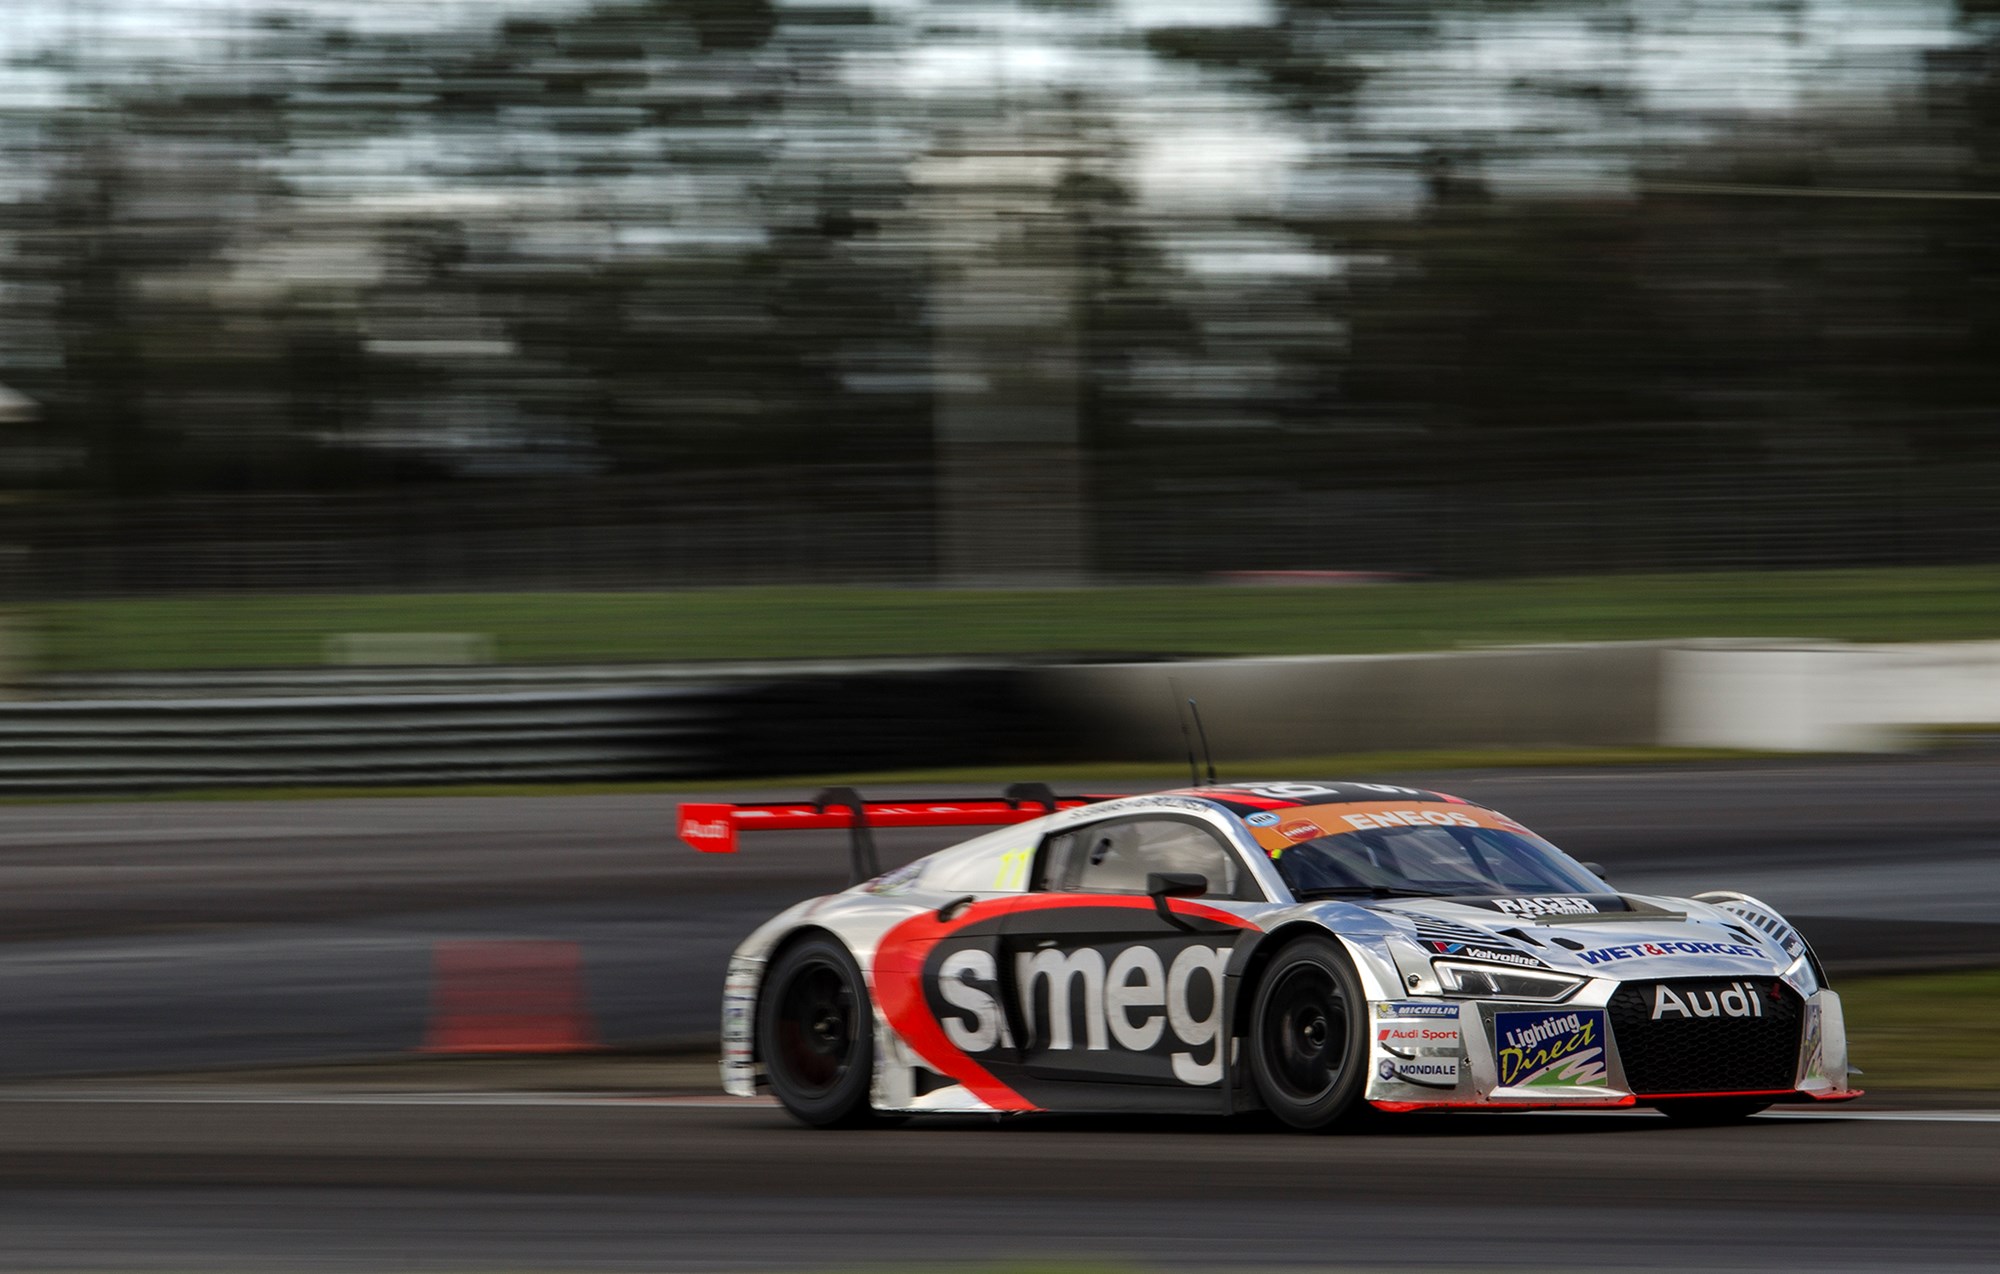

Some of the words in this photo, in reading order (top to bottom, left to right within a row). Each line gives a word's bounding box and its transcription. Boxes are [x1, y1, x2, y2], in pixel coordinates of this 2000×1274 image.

[681, 819, 729, 838] Audi
[1341, 810, 1480, 831] ENEOS
[1491, 897, 1599, 915] RACER
[1466, 947, 1540, 966] Valvoline
[1576, 943, 1769, 965] WET&FORGET
[1398, 1005, 1459, 1016] MICHELIN
[1651, 982, 1762, 1020] Audi
[938, 944, 1234, 1085] smeg
[1391, 1029, 1419, 1039] Audi
[1422, 1029, 1458, 1041] Sport
[1506, 1012, 1581, 1050] Lighting
[1500, 1019, 1596, 1085] Direct
[1400, 1064, 1456, 1076] MONDIALE
